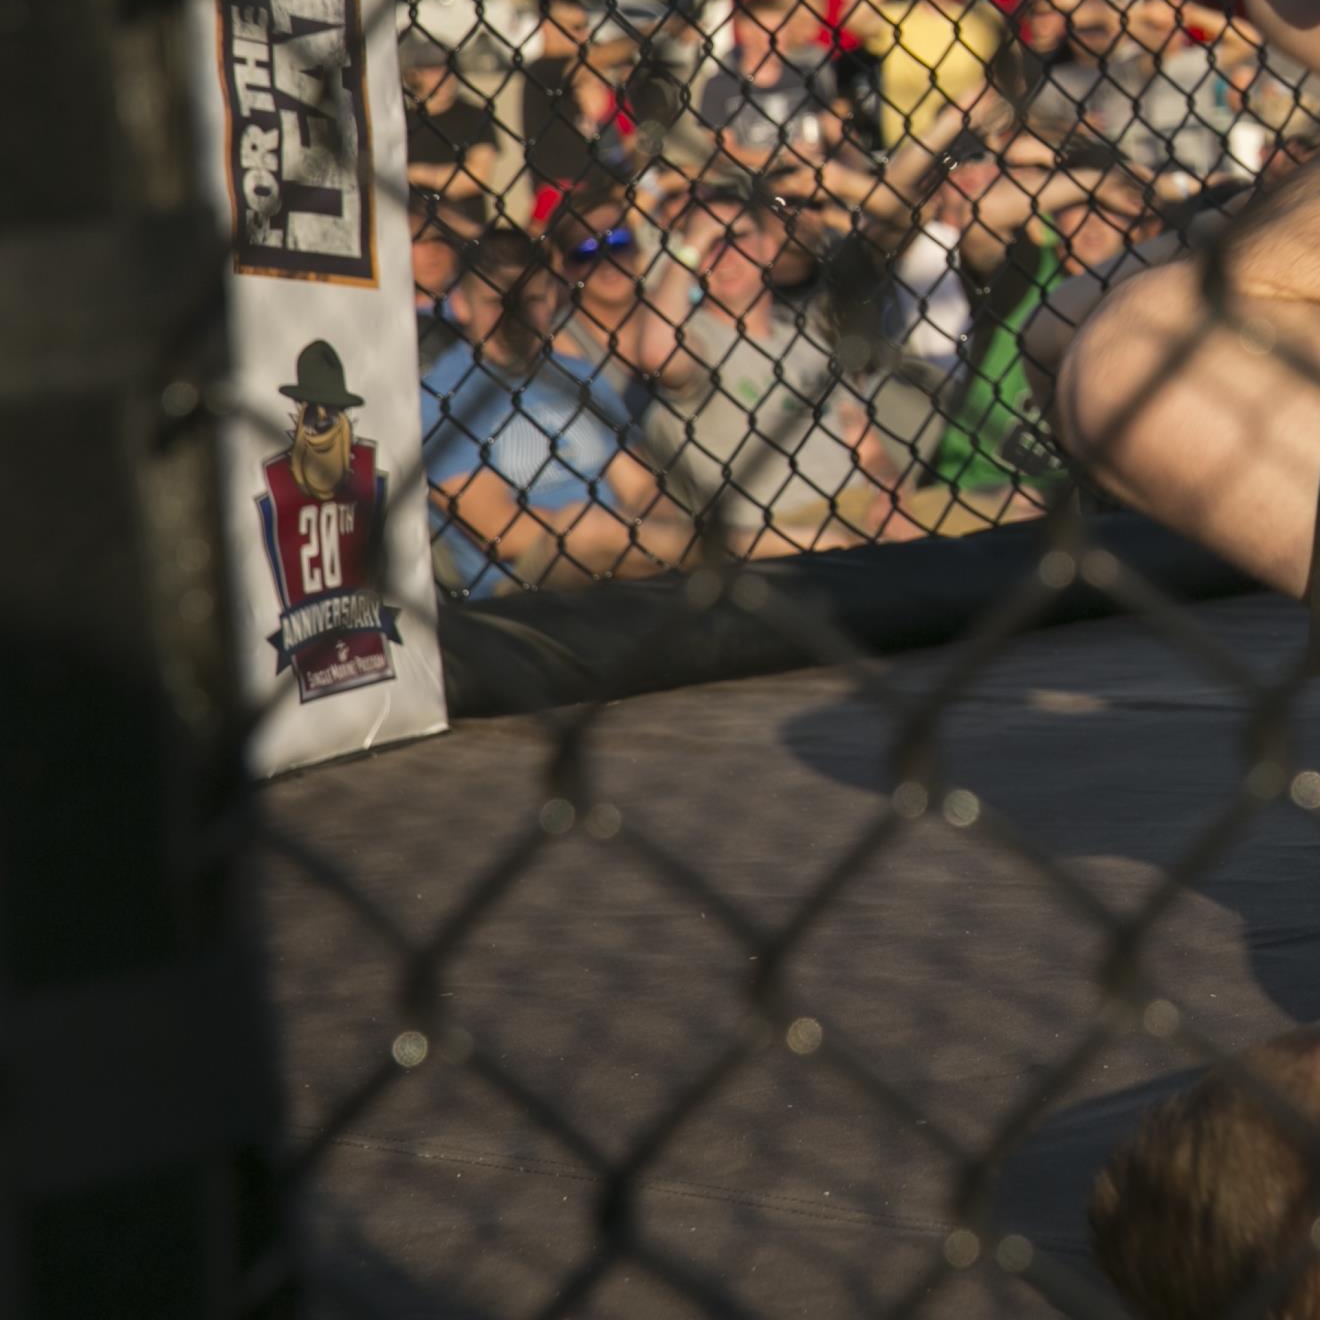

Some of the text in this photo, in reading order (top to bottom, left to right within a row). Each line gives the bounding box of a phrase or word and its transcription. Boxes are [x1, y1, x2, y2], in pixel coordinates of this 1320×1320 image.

[231, 4, 284, 248] FOR THE
[281, 594, 382, 650] ANNIVERSARY
